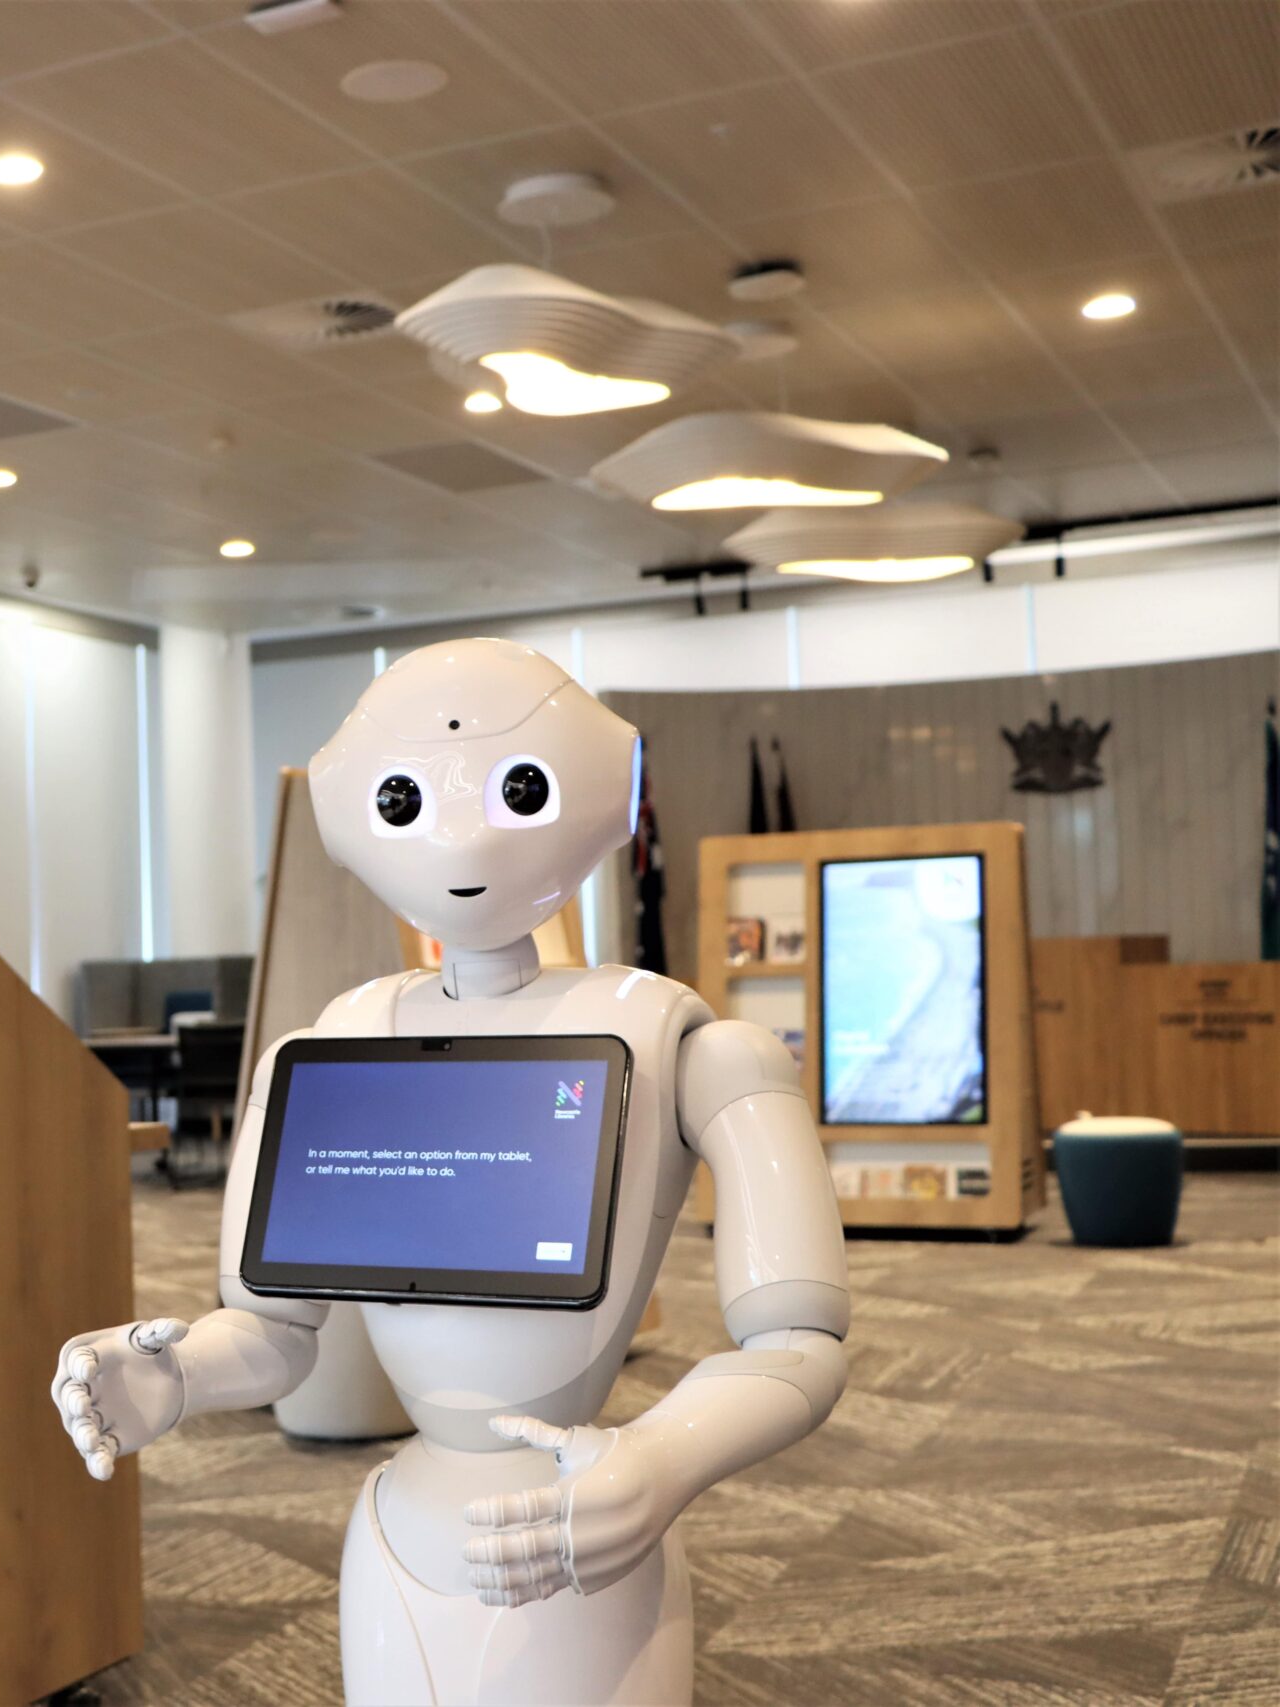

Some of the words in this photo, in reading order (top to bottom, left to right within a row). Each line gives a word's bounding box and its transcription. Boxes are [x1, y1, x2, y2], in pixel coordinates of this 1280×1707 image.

[308, 1149, 317, 1158] In
[319, 1150, 326, 1158] a
[328, 1149, 370, 1159] moment,
[372, 1149, 402, 1159] select
[404, 1151, 418, 1159] an
[420, 1150, 452, 1161] option
[455, 1150, 478, 1160] from
[480, 1152, 496, 1162] my
[498, 1150, 532, 1162] tablet,
[305, 1166, 316, 1174] or
[318, 1165, 333, 1174] tell
[334, 1166, 350, 1175] me
[352, 1165, 377, 1175] what
[379, 1166, 406, 1177] you'd
[407, 1166, 425, 1176] like
[427, 1167, 438, 1176] to
[440, 1166, 456, 1176] do.
